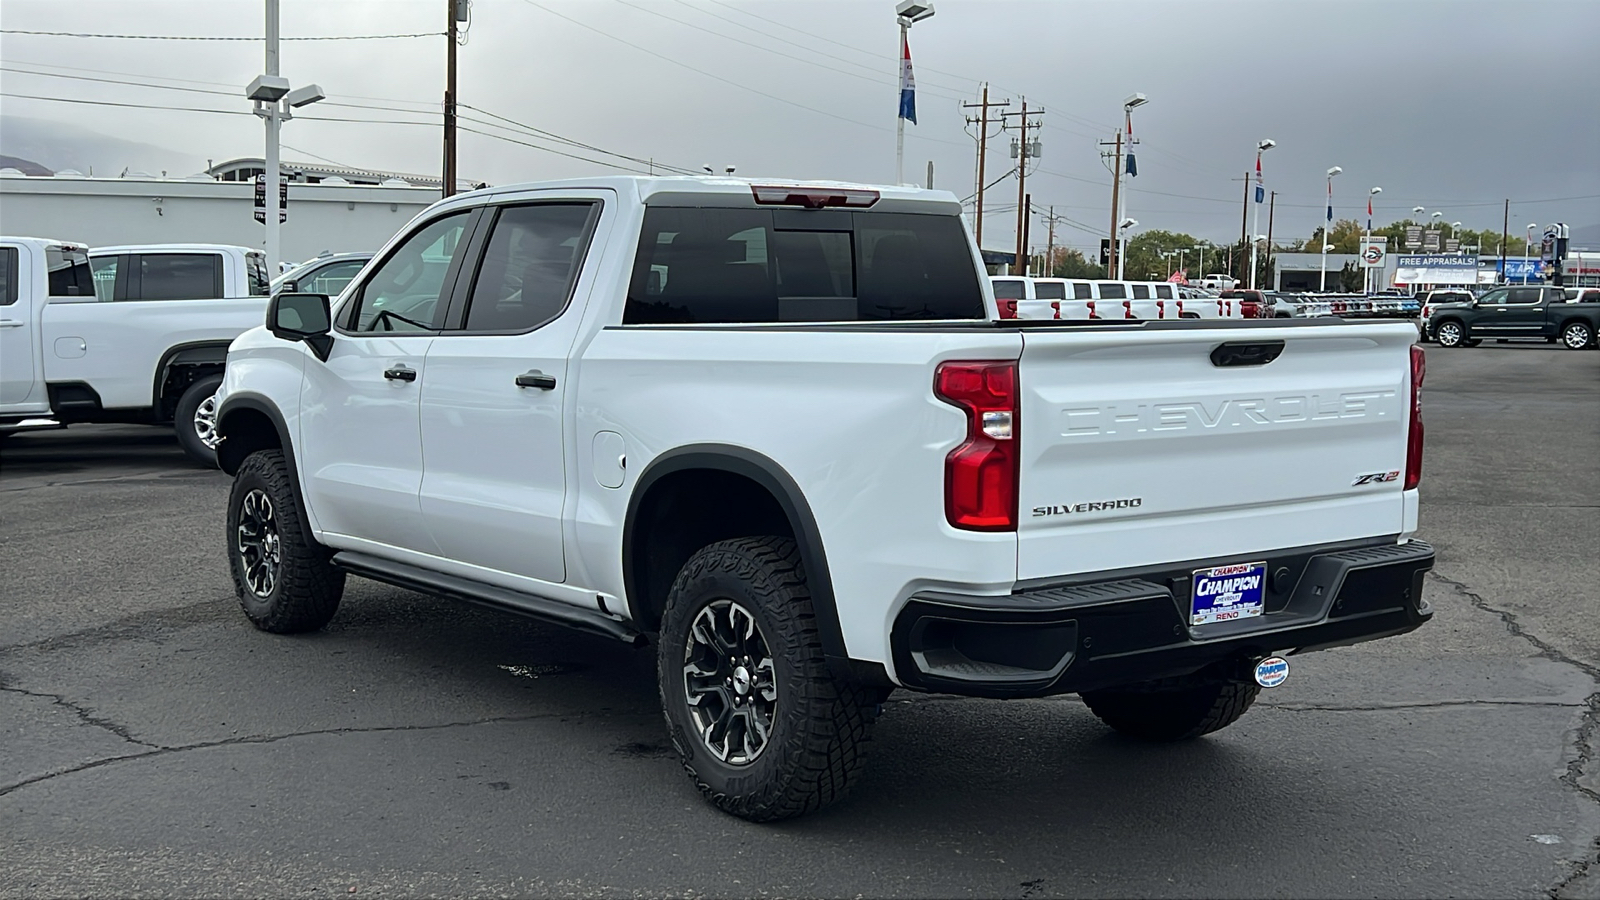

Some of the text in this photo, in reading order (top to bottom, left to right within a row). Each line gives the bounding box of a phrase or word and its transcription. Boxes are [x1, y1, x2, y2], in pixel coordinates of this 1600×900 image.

[1400, 257, 1476, 266] FREE APPRAISALS!
[1061, 390, 1395, 437] CHEVROLET
[1351, 470, 1400, 487] ZR2
[1032, 498, 1142, 517] SILVERADO
[1213, 565, 1249, 576] CHAMPION
[1196, 575, 1260, 597] CHAMPION
[1216, 611, 1239, 620] RENO
